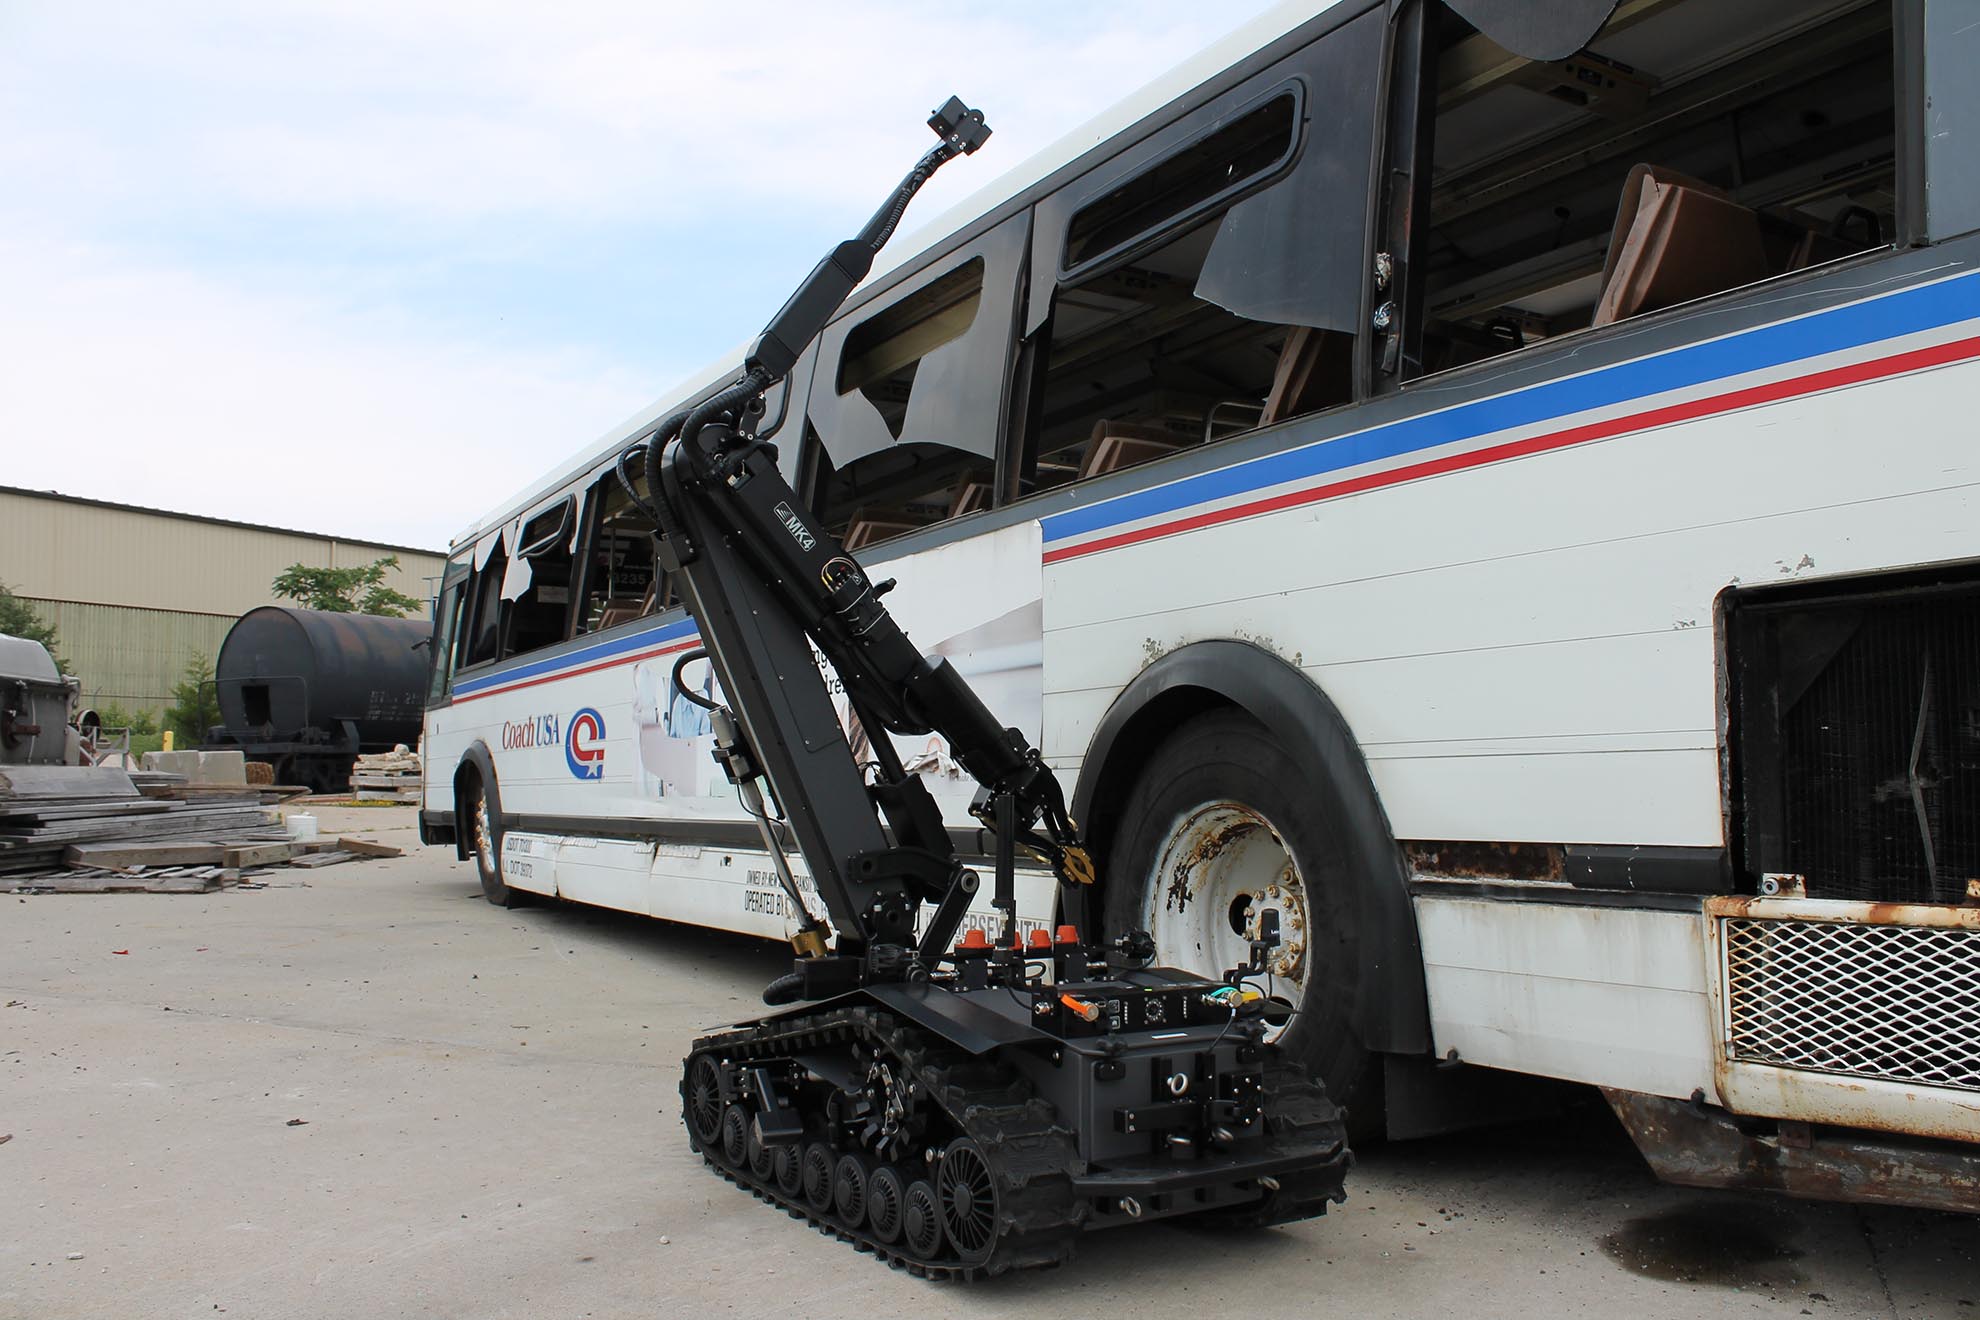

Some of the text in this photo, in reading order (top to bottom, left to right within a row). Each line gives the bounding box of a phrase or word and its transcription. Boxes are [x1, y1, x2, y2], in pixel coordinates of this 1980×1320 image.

[786, 516, 814, 549] MK4
[502, 713, 560, 750] Coach USA
[745, 889, 774, 915] OPERATED
[776, 893, 784, 916] BY
[1015, 919, 1042, 942] IT
